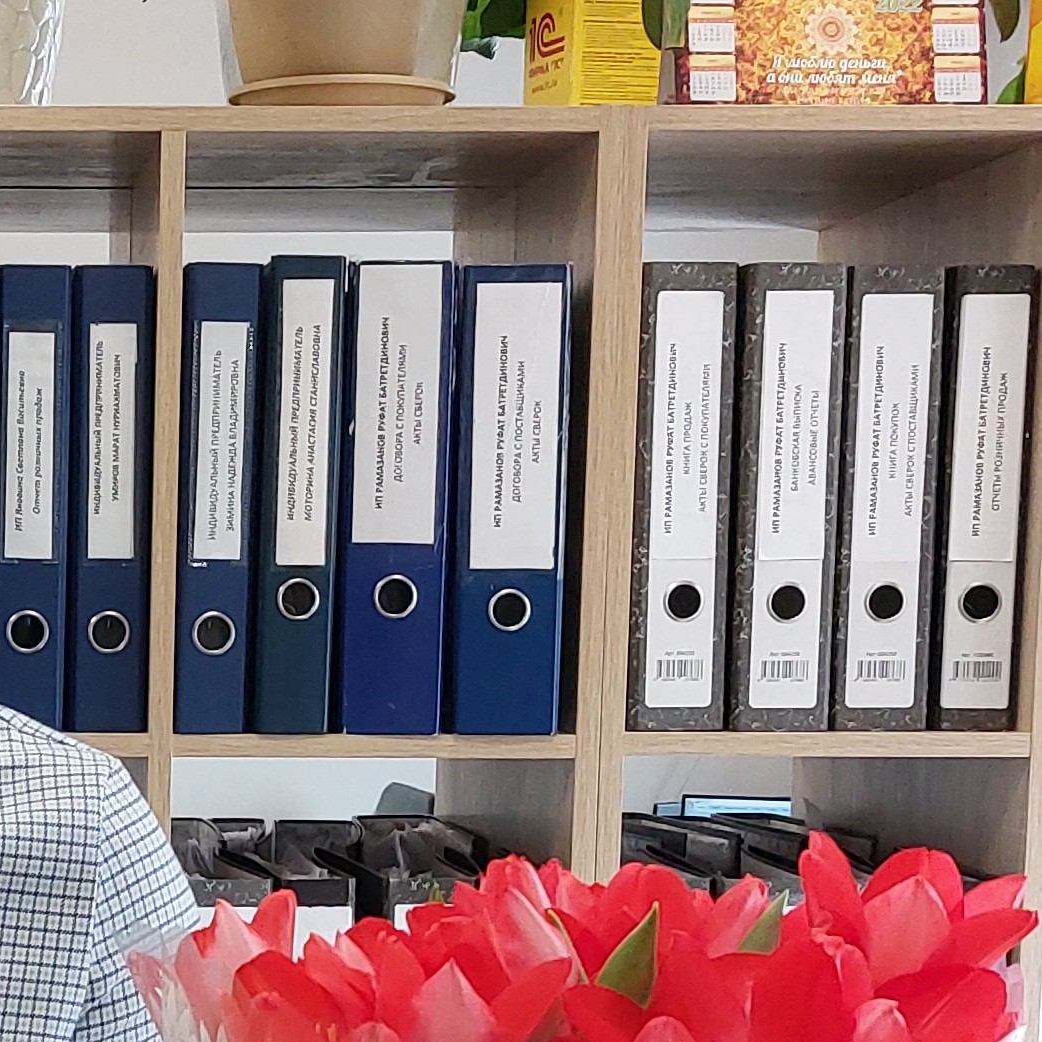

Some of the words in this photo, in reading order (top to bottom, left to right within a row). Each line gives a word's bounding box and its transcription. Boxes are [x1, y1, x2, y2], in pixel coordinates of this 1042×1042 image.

[94, 340, 104, 428] ПРЕДПРИНИМАТЕЛЬ
[290, 326, 304, 424] ПРЕДПРИНИМАТЕЛЬ
[309, 324, 322, 407] СТАНИСЛАВОВНА
[395, 344, 407, 422] ПОКУПАТЕЛЯМИ
[16, 370, 25, 425] Васильевна
[33, 387, 44, 426] продаж
[210, 350, 222, 446] ПРЕДПРИНИМАТЕЛЬ
[228, 359, 240, 440] ВЛАДИМИРОВНА
[413, 381, 424, 418] СВЕРОК
[514, 360, 526, 442] ПОСТАВЩИКАМИ
[700, 363, 712, 441] ПОКУПАТЕЛЯМИ
[792, 383, 803, 430] ВЫПИСКА
[809, 390, 820, 428] ОТЧЕТЫ
[906, 364, 920, 447] ПОСТАВЩИКАМИ
[997, 372, 1009, 414] ПРОДАЖ
[306, 408, 318, 466] АНАСТАСИЯ
[377, 400, 387, 432] РУФАТ
[413, 419, 422, 446] АКТЫ
[496, 418, 506, 450] РУФАТ
[532, 400, 542, 437] СВЕРОК
[683, 401, 693, 443] ПРОДАЖ
[889, 402, 900, 447] ПОКУПОК
[15, 426, 25, 475] Светлана
[34, 426, 43, 479] розничных
[111, 432, 121, 463] МАРАТ
[393, 431, 404, 483] ДОГОВОРА
[531, 437, 541, 464] АКТЫ
[666, 425, 675, 457] РУФАТ
[682, 444, 692, 475] КНИГА
[774, 425, 784, 456] РУФАТ
[790, 431, 801, 492] БАНКОВСКАЯ
[807, 429, 819, 486] АВАНСОВЫЕ
[871, 428, 882, 459] РУФАТ
[976, 429, 987, 460] РУФАТ
[993, 415, 1005, 473] РОЗНИЧНЫХ
[92, 429, 103, 515] ИНДИВИДУАЛЬНЫЙ
[227, 441, 238, 489] НАДЕЖДА
[286, 425, 299, 521] ИНДИВИДУАЛЬНЫЙ
[375, 433, 386, 494] РАМАЗАНОВ
[493, 452, 504, 512] РАМАЗАНОВ
[511, 451, 522, 503] ДОГОВОРА
[699, 449, 709, 486] СВЕРОК
[888, 448, 897, 479] КНИГА
[904, 454, 915, 491] СВЕРОК
[206, 448, 220, 541] ИНДИВИДУАЛЬНЫЙ
[303, 466, 314, 522] МОТОРИНА
[374, 495, 384, 510] ИП
[664, 458, 674, 518] РАМАЗАНОВ
[698, 487, 708, 513] АКТЫ
[772, 458, 783, 518] РАМАЗАНОВ
[868, 461, 879, 520] РАМАЗАНОВ
[904, 491, 914, 517] АКТЫ
[972, 462, 984, 522] РАМАЗАНОВ
[991, 474, 1002, 512] ОТЧЕТЫ
[14, 516, 23, 532] ИП
[225, 490, 236, 532] ЗИМИНА
[493, 513, 502, 528] ИП
[664, 520, 673, 534] ИП
[771, 519, 781, 534] ИП
[868, 521, 877, 536] ИП
[971, 523, 981, 537] ИП
